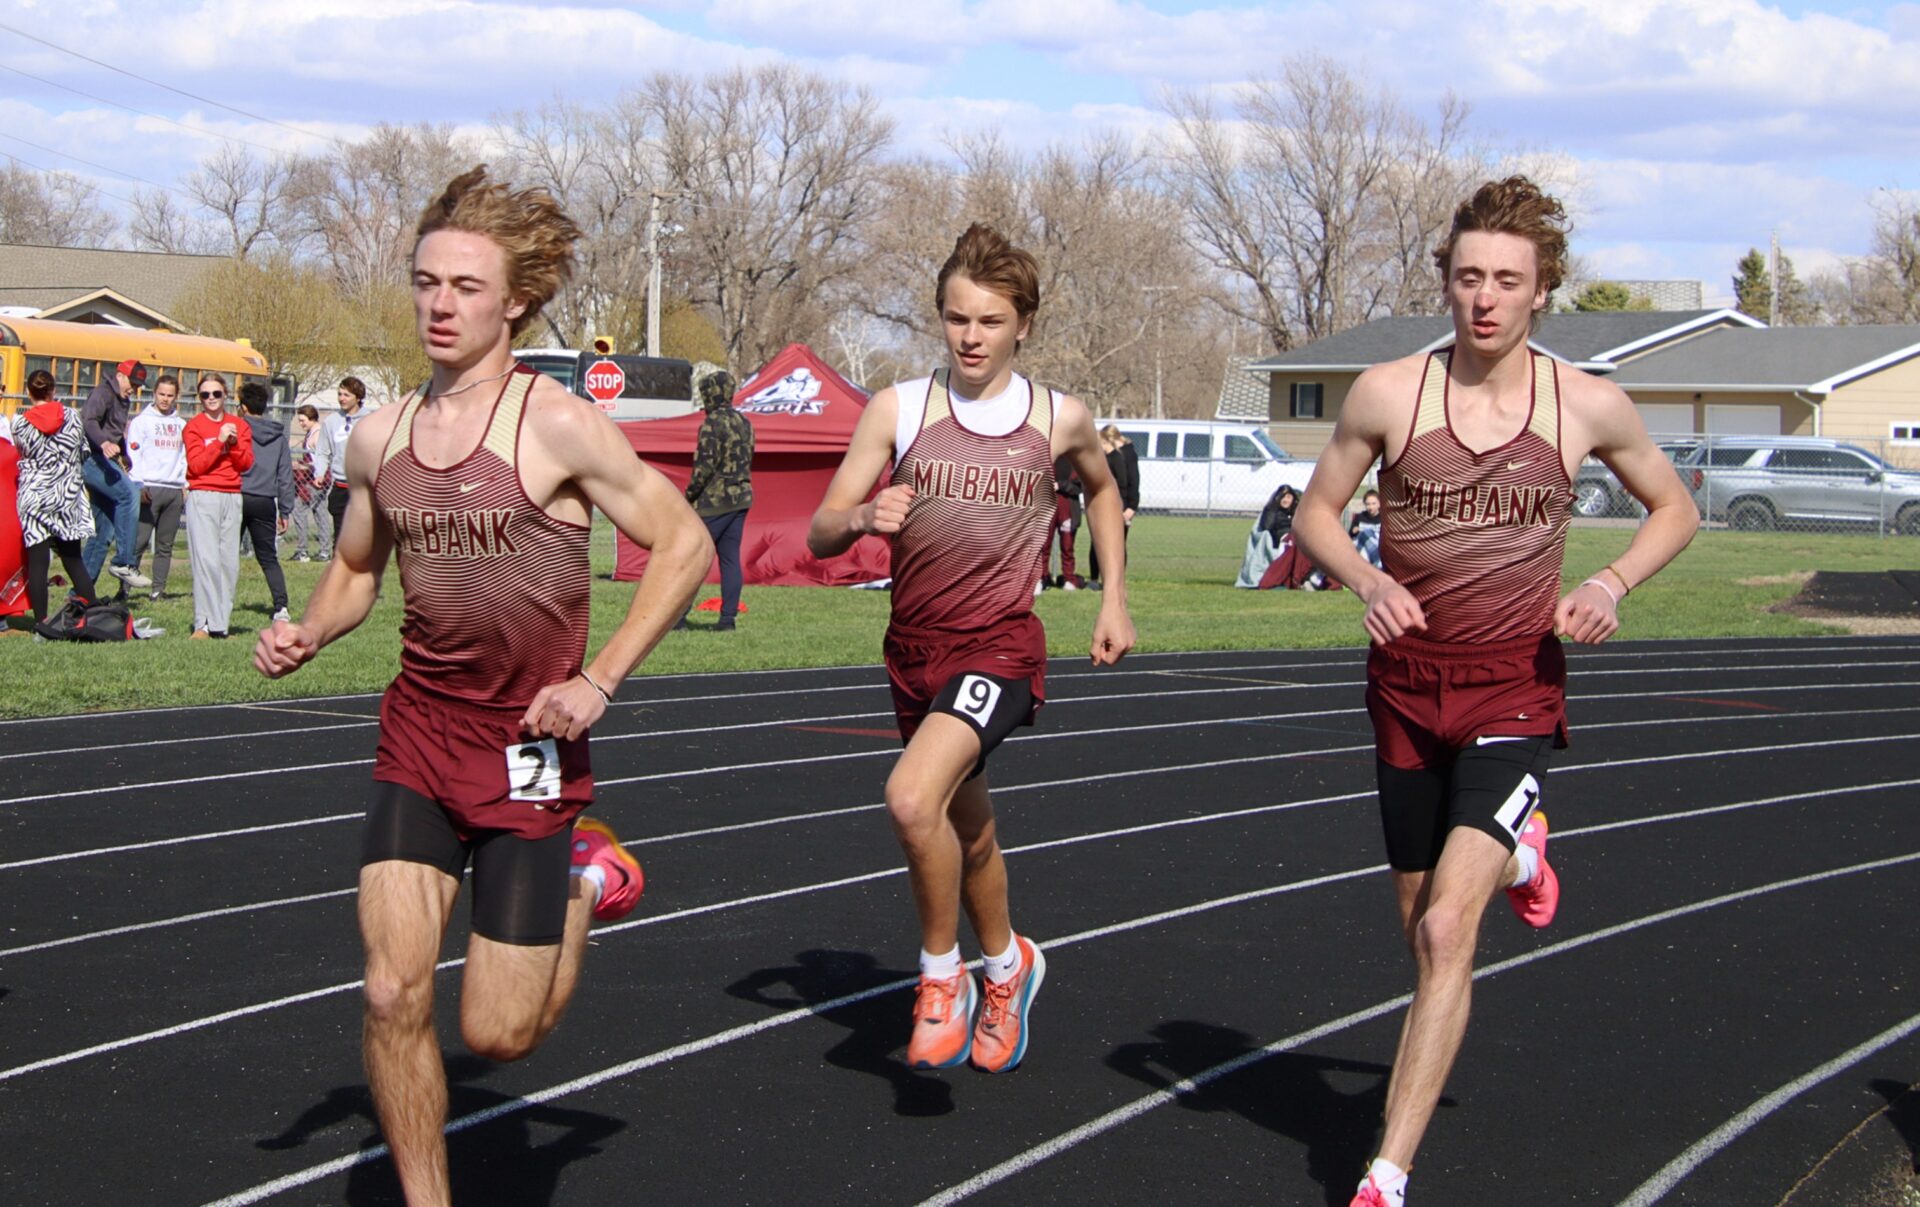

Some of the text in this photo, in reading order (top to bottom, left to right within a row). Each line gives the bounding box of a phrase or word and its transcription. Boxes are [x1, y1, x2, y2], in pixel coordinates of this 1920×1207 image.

[588, 374, 622, 389] STOP
[913, 459, 1043, 508] MILBANK
[1403, 475, 1554, 528] MILBANK
[386, 508, 523, 558] ILBANK
[964, 679, 991, 714] 9
[518, 746, 549, 796] 2
[1510, 788, 1537, 833] 1
